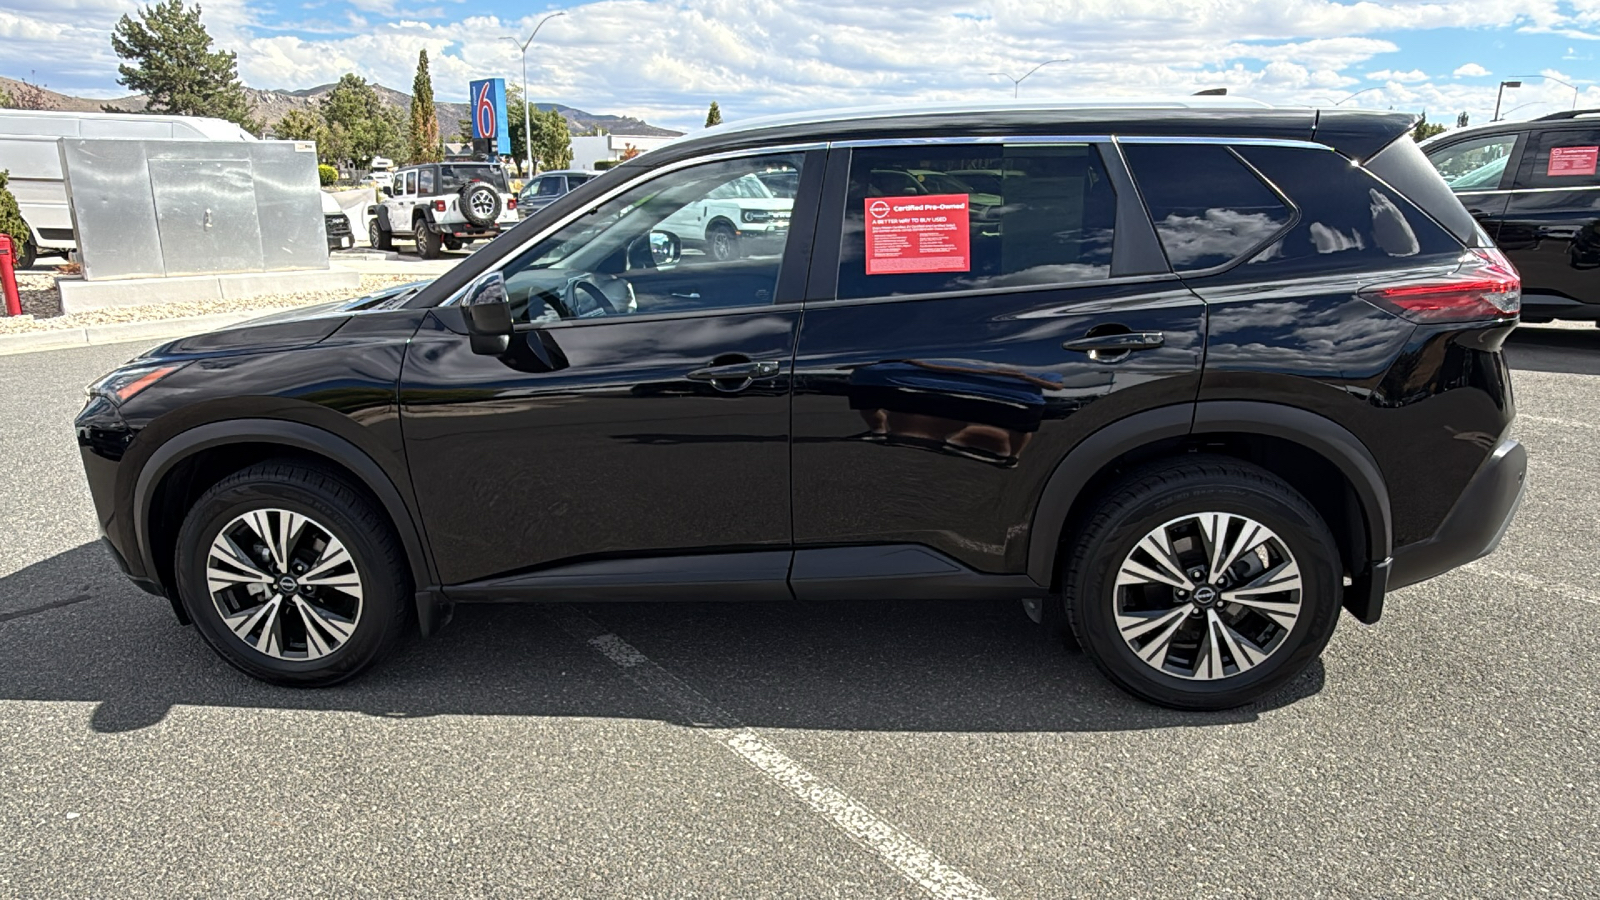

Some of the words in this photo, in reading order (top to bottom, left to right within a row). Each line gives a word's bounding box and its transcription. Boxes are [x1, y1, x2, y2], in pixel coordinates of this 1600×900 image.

[477, 82, 495, 138] 6
[893, 204, 923, 212] Certified
[924, 202, 965, 211] Pre-Owned
